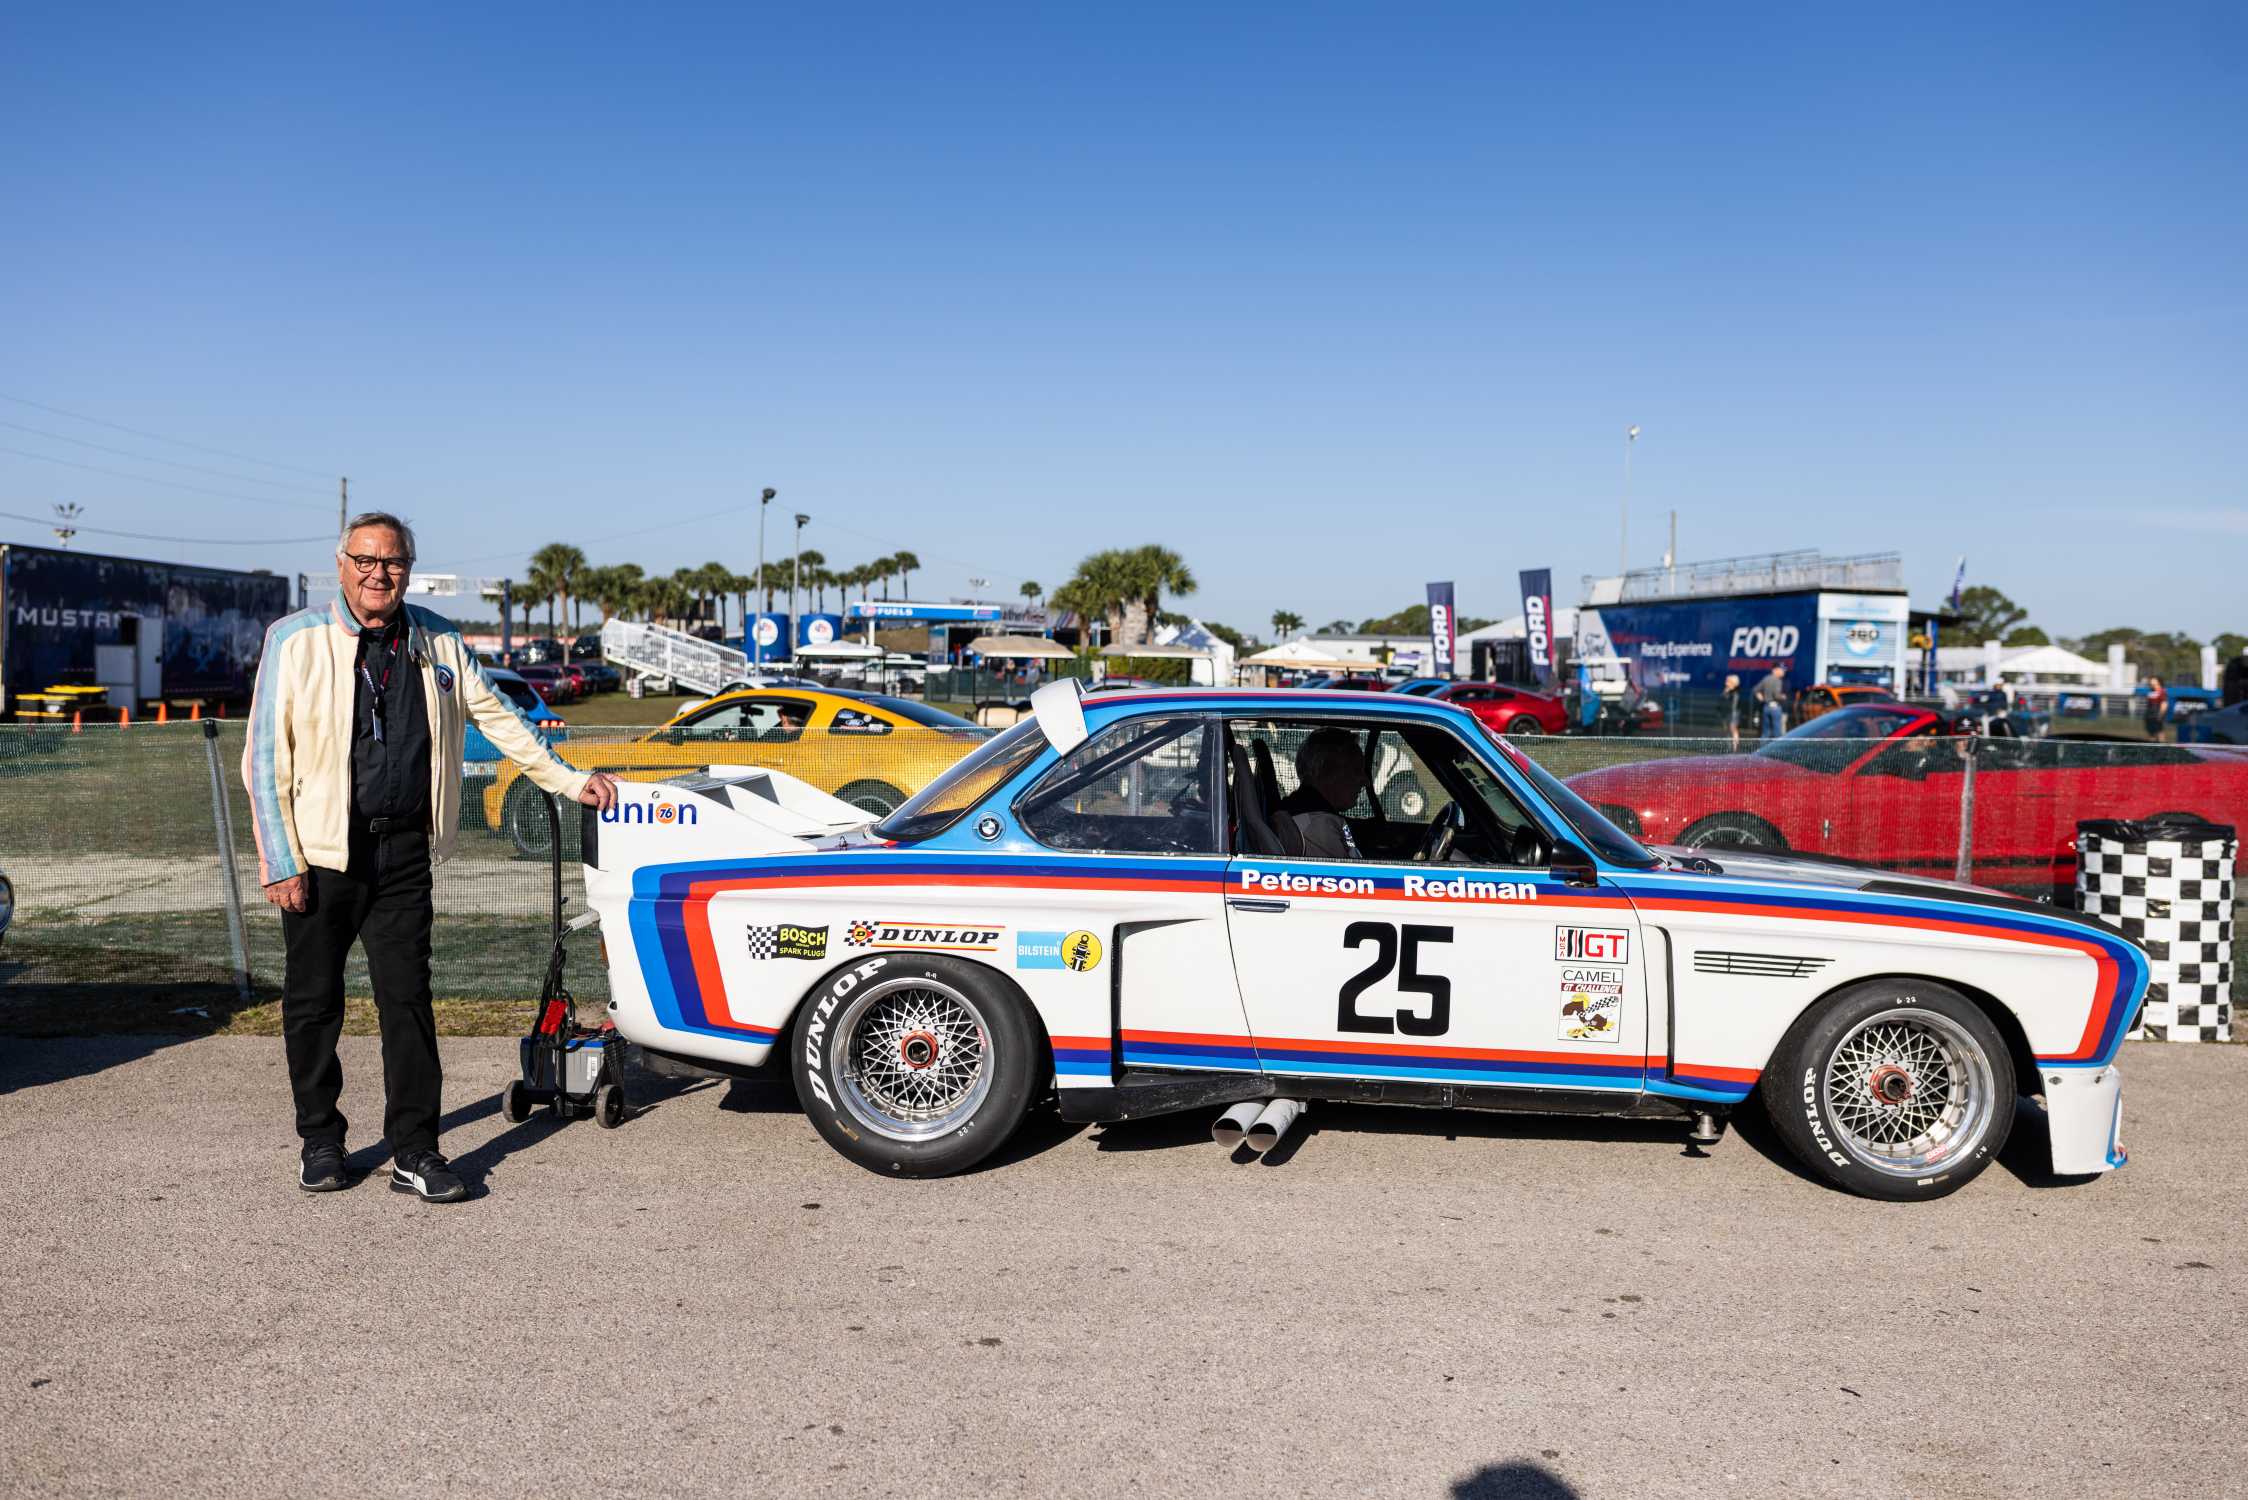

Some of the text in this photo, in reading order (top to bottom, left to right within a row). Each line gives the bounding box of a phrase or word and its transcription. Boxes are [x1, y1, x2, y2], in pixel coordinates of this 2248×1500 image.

[877, 607, 913, 616] FUELS
[1431, 604, 1451, 664] FORD
[1526, 595, 1549, 665] FORD
[1641, 641, 1712, 658] Racing Experience
[1729, 625, 1799, 657] FORD
[659, 807, 673, 819] 76
[1241, 869, 1537, 901] Peterson Redman
[779, 927, 827, 946] BOSCH
[878, 928, 1000, 944] DUNLOP
[1584, 933, 1625, 958] GT
[779, 947, 825, 957] SPARK PLUGS
[1017, 944, 1060, 957] BILSTEIN
[1337, 921, 1454, 1037] 25
[1562, 969, 1621, 983] CAMEL
[1562, 983, 1620, 994] GT CHALLENGE
[806, 957, 888, 1112] DUNLOP
[1803, 1067, 1851, 1167] DUNLOP
